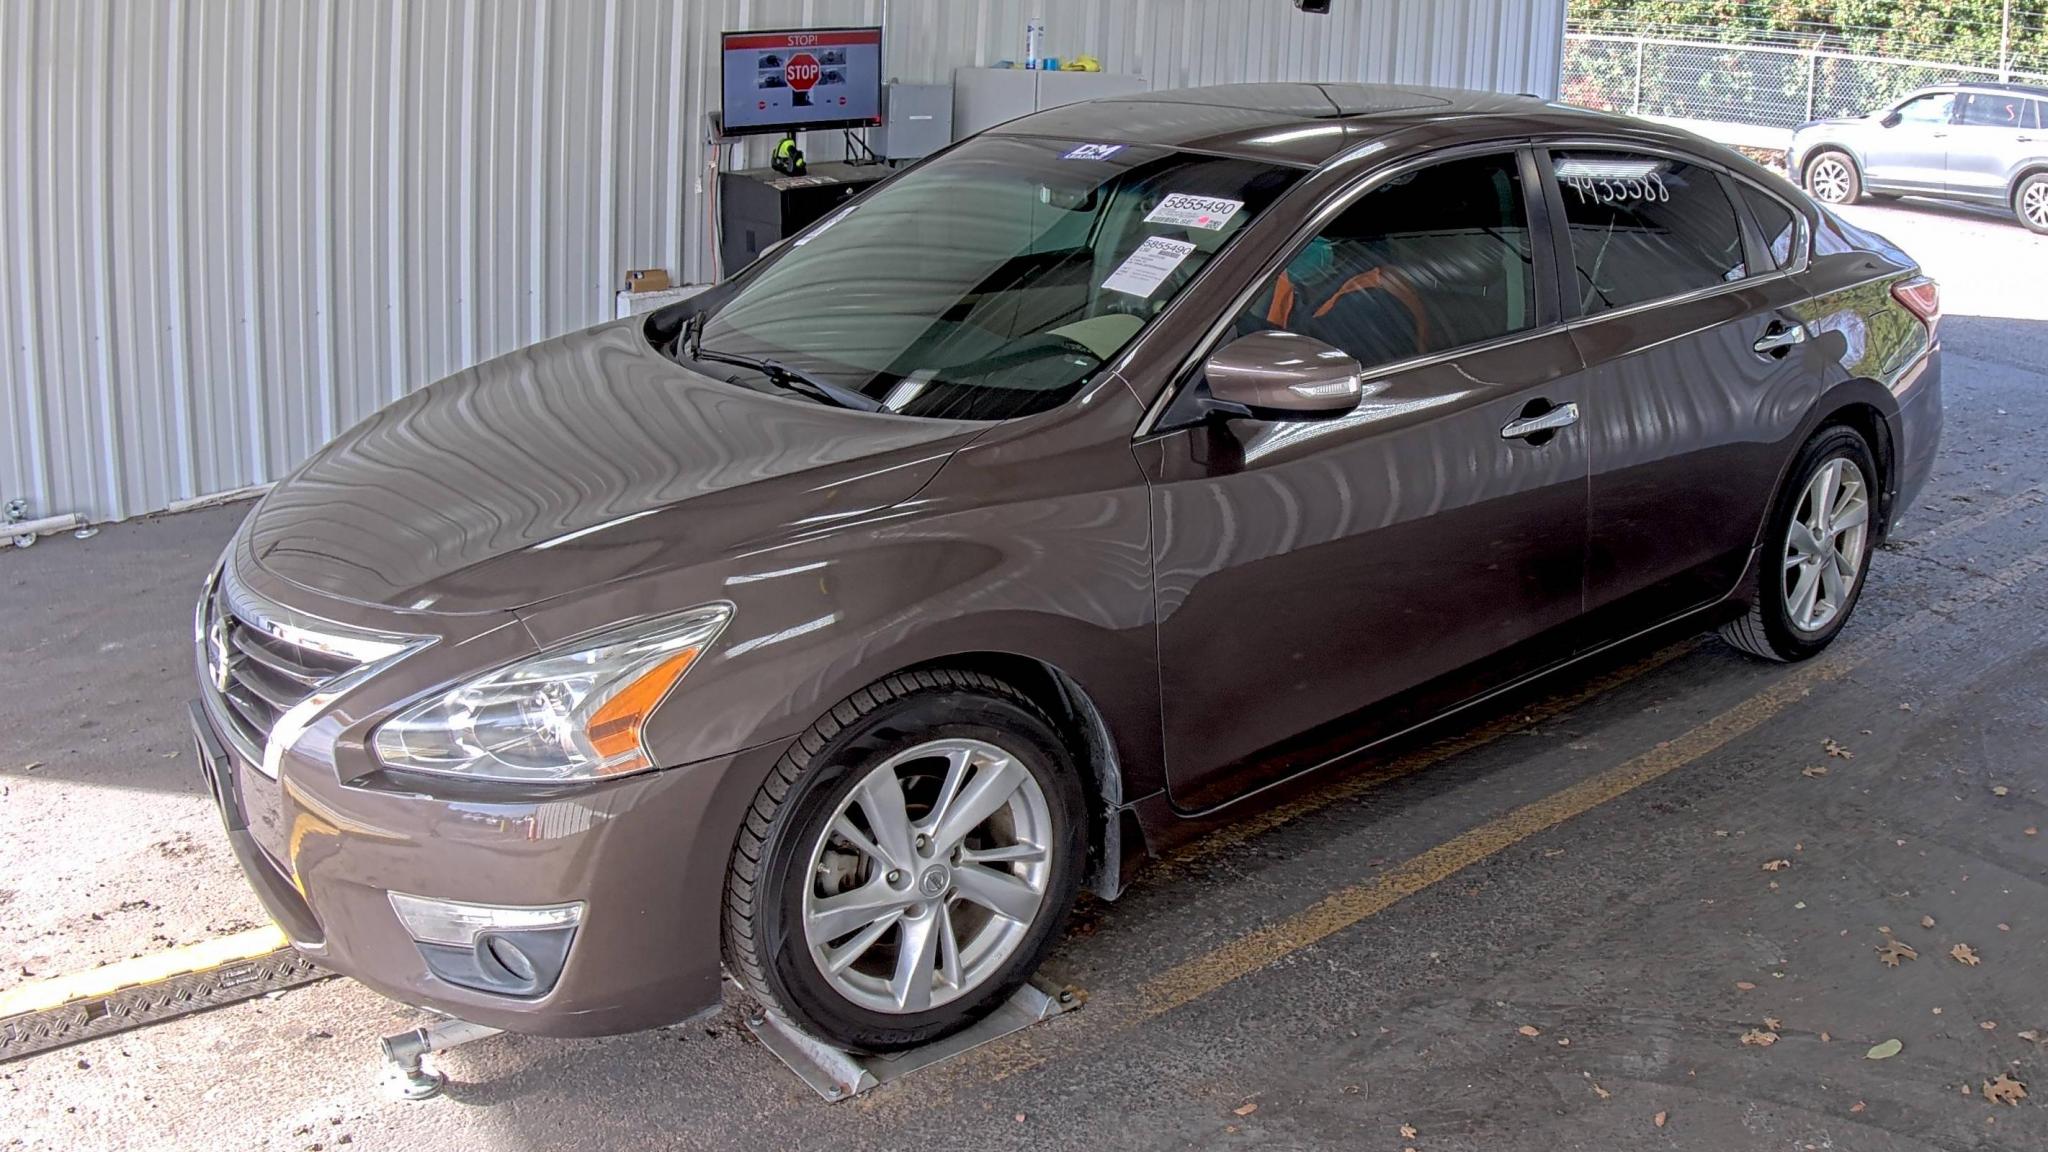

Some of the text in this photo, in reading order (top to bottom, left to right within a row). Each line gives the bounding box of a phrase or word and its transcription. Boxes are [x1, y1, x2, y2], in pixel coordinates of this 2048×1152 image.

[787, 34, 818, 47] STOP!
[787, 65, 818, 80] STOP
[1164, 196, 1235, 215] 5855490
[1143, 240, 1191, 255] 5855490
